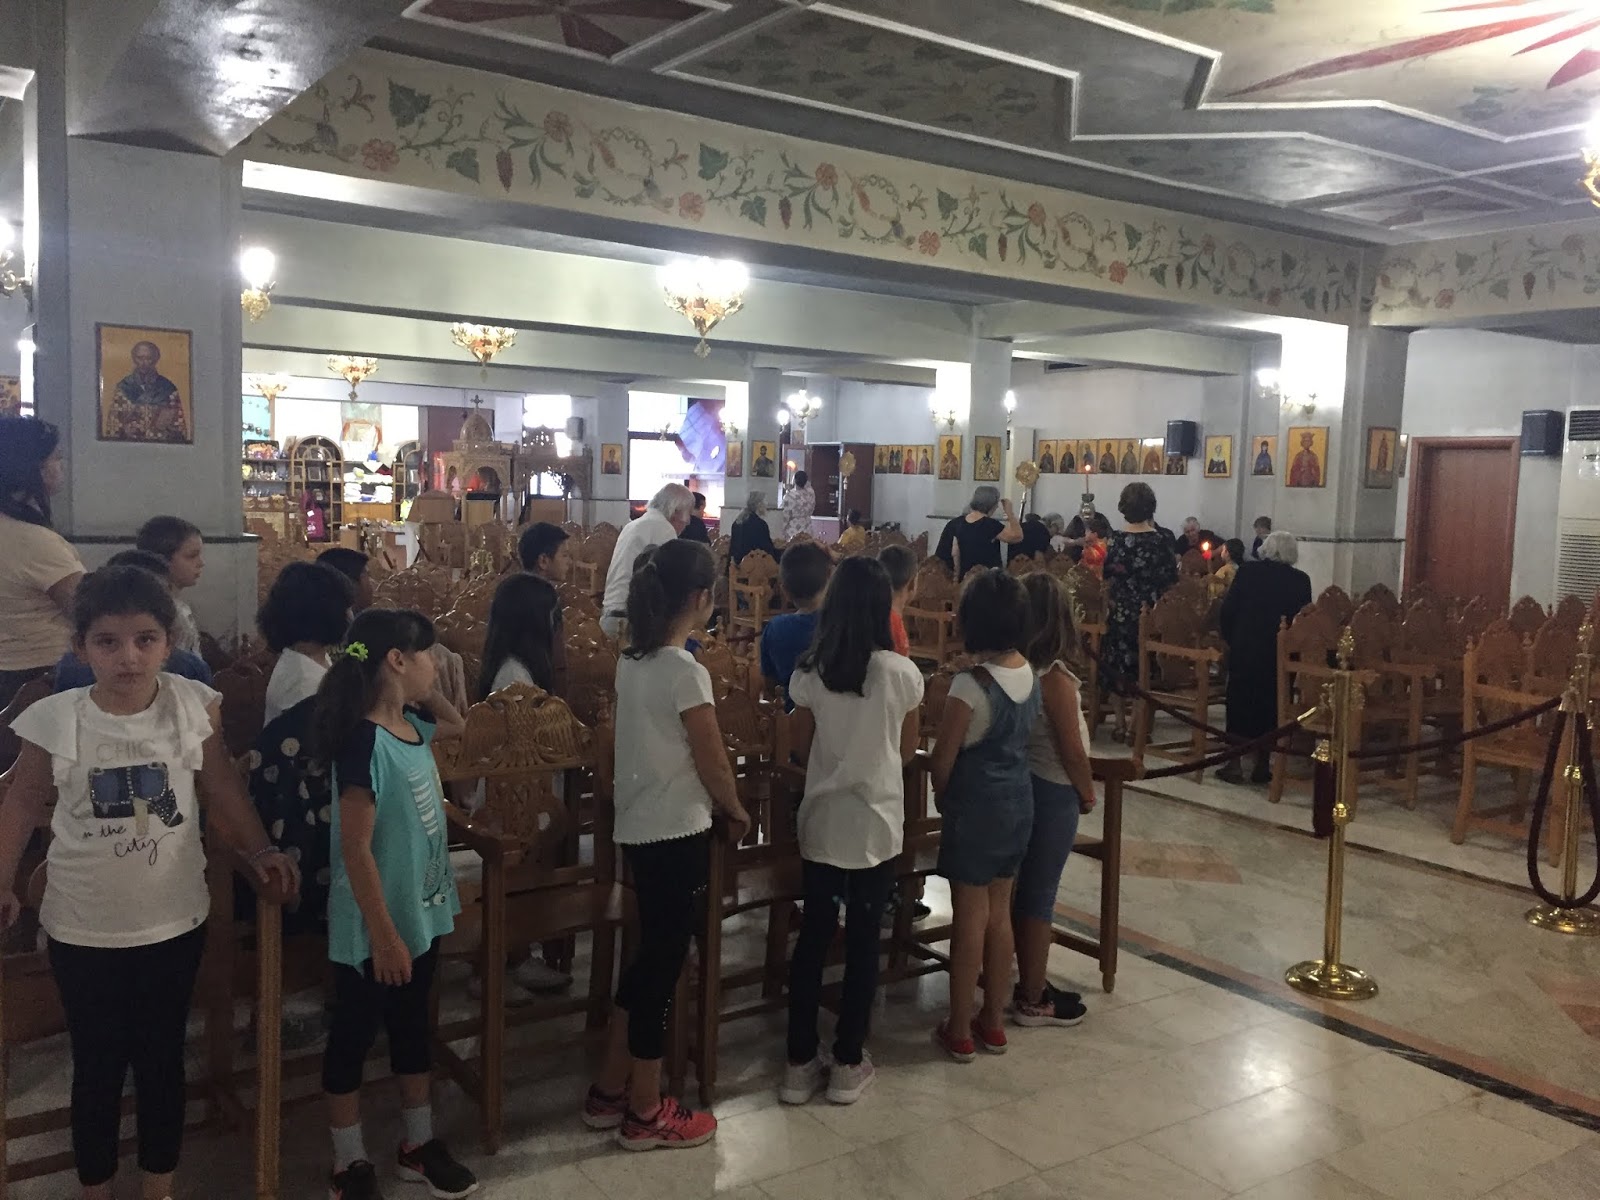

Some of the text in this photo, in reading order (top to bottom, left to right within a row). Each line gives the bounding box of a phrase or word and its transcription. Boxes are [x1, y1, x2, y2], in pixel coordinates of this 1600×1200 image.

[96, 739, 156, 761] CHIC
[100, 824, 127, 838] the
[114, 831, 176, 866] city
